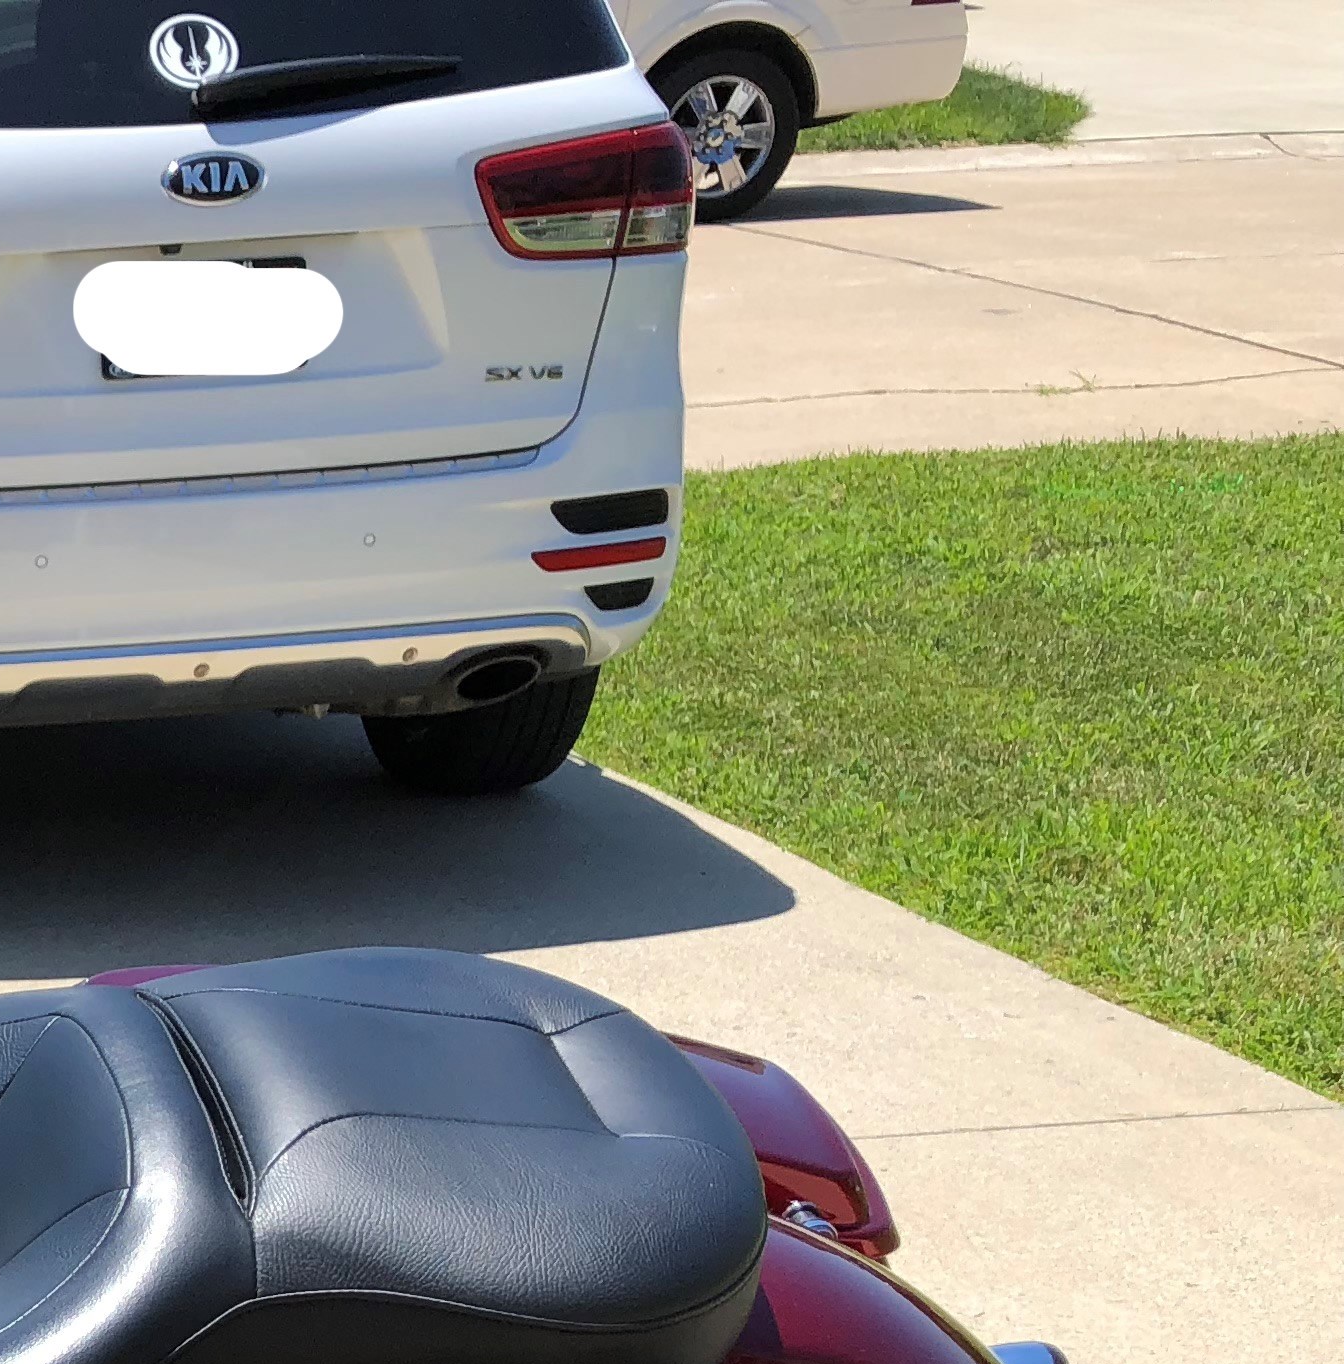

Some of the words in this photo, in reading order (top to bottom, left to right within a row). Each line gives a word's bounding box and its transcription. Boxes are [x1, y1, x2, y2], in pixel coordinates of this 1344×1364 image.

[180, 160, 250, 195] KIA
[485, 365, 522, 381] SX
[529, 364, 563, 380] V6
